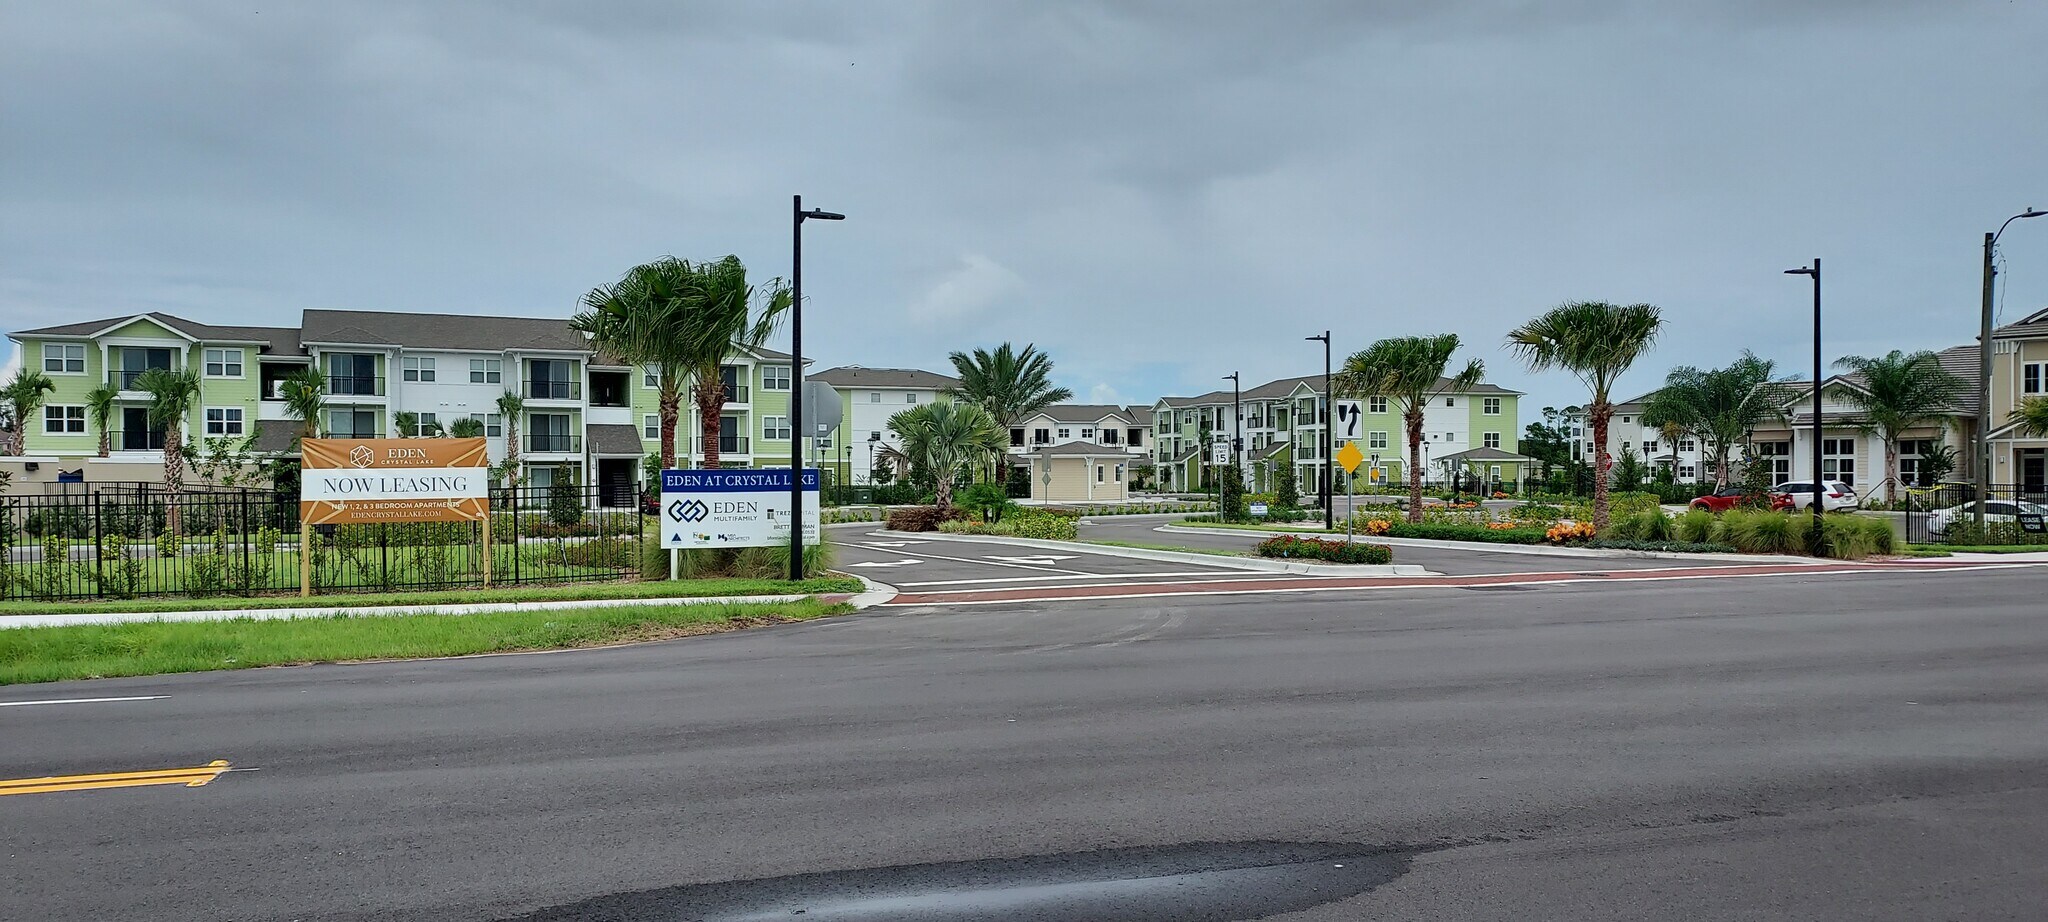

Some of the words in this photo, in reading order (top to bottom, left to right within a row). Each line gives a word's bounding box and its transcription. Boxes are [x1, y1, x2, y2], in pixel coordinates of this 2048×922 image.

[388, 448, 426, 458] EDEN
[1216, 454, 1226, 462] 15
[323, 478, 374, 494] NOW
[380, 476, 467, 493] LEASING
[666, 475, 701, 486] EDEN
[705, 475, 722, 486] AT
[725, 475, 780, 486] CRYSTAL
[784, 474, 815, 485] LKE
[714, 502, 758, 513] EDEN
